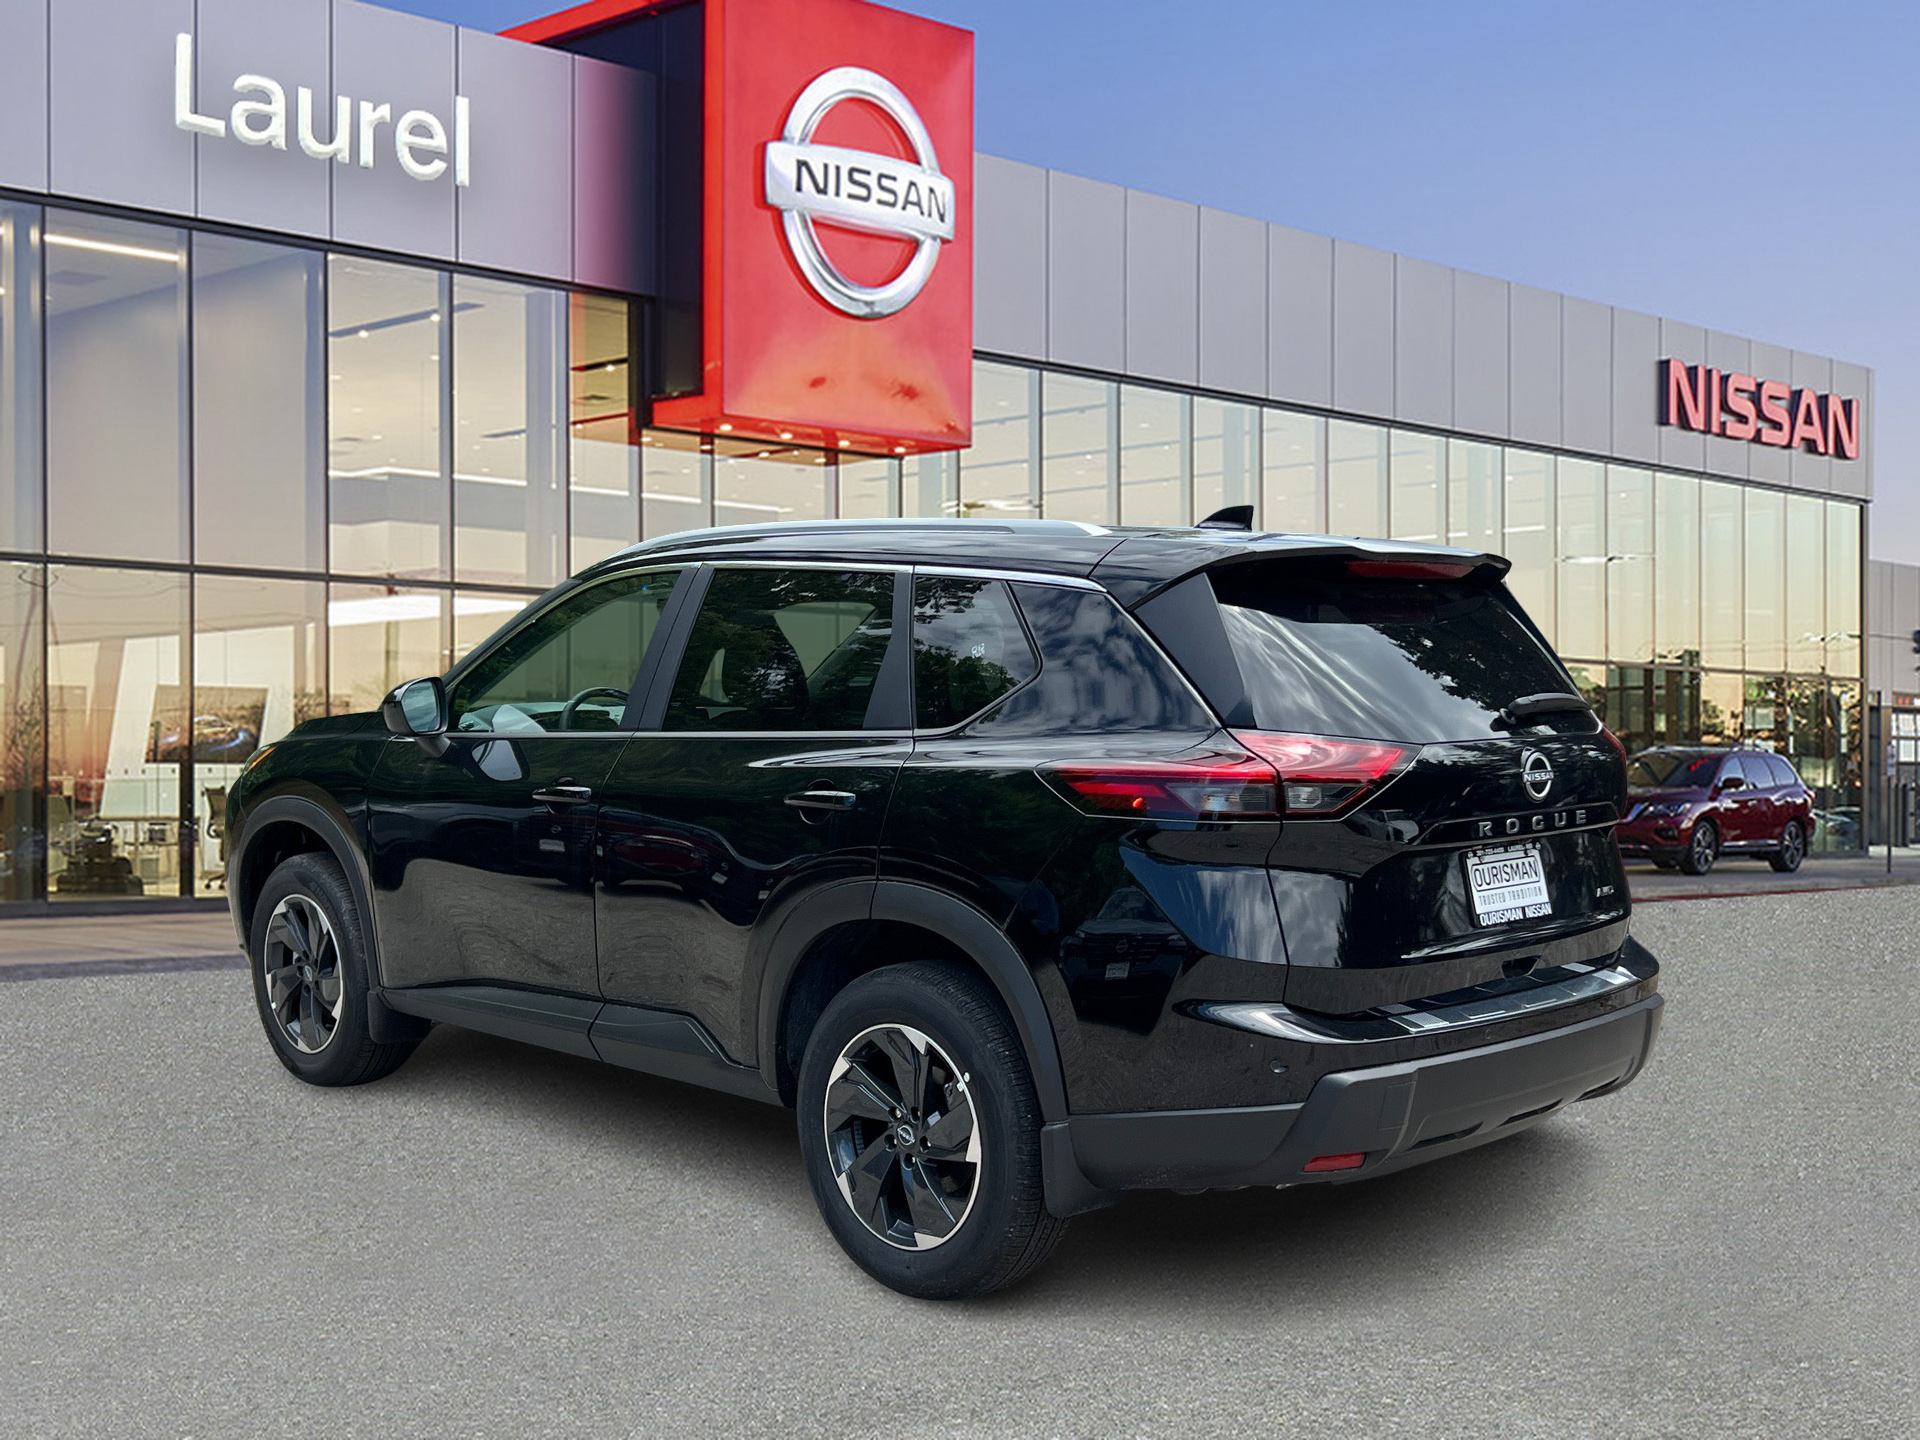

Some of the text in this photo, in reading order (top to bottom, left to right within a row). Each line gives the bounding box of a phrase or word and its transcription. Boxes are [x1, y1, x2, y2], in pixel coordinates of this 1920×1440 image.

[175, 32, 470, 188] Laurel
[795, 158, 947, 224] NISSAN
[1659, 358, 1860, 460] NISSAN
[1523, 771, 1554, 782] NISSAN
[1478, 809, 1587, 837] ROGUE
[1473, 860, 1539, 888] OURISMAN
[1478, 892, 1506, 907] TRUSTED
[1479, 902, 1553, 927] OURISMAN NISSAN
